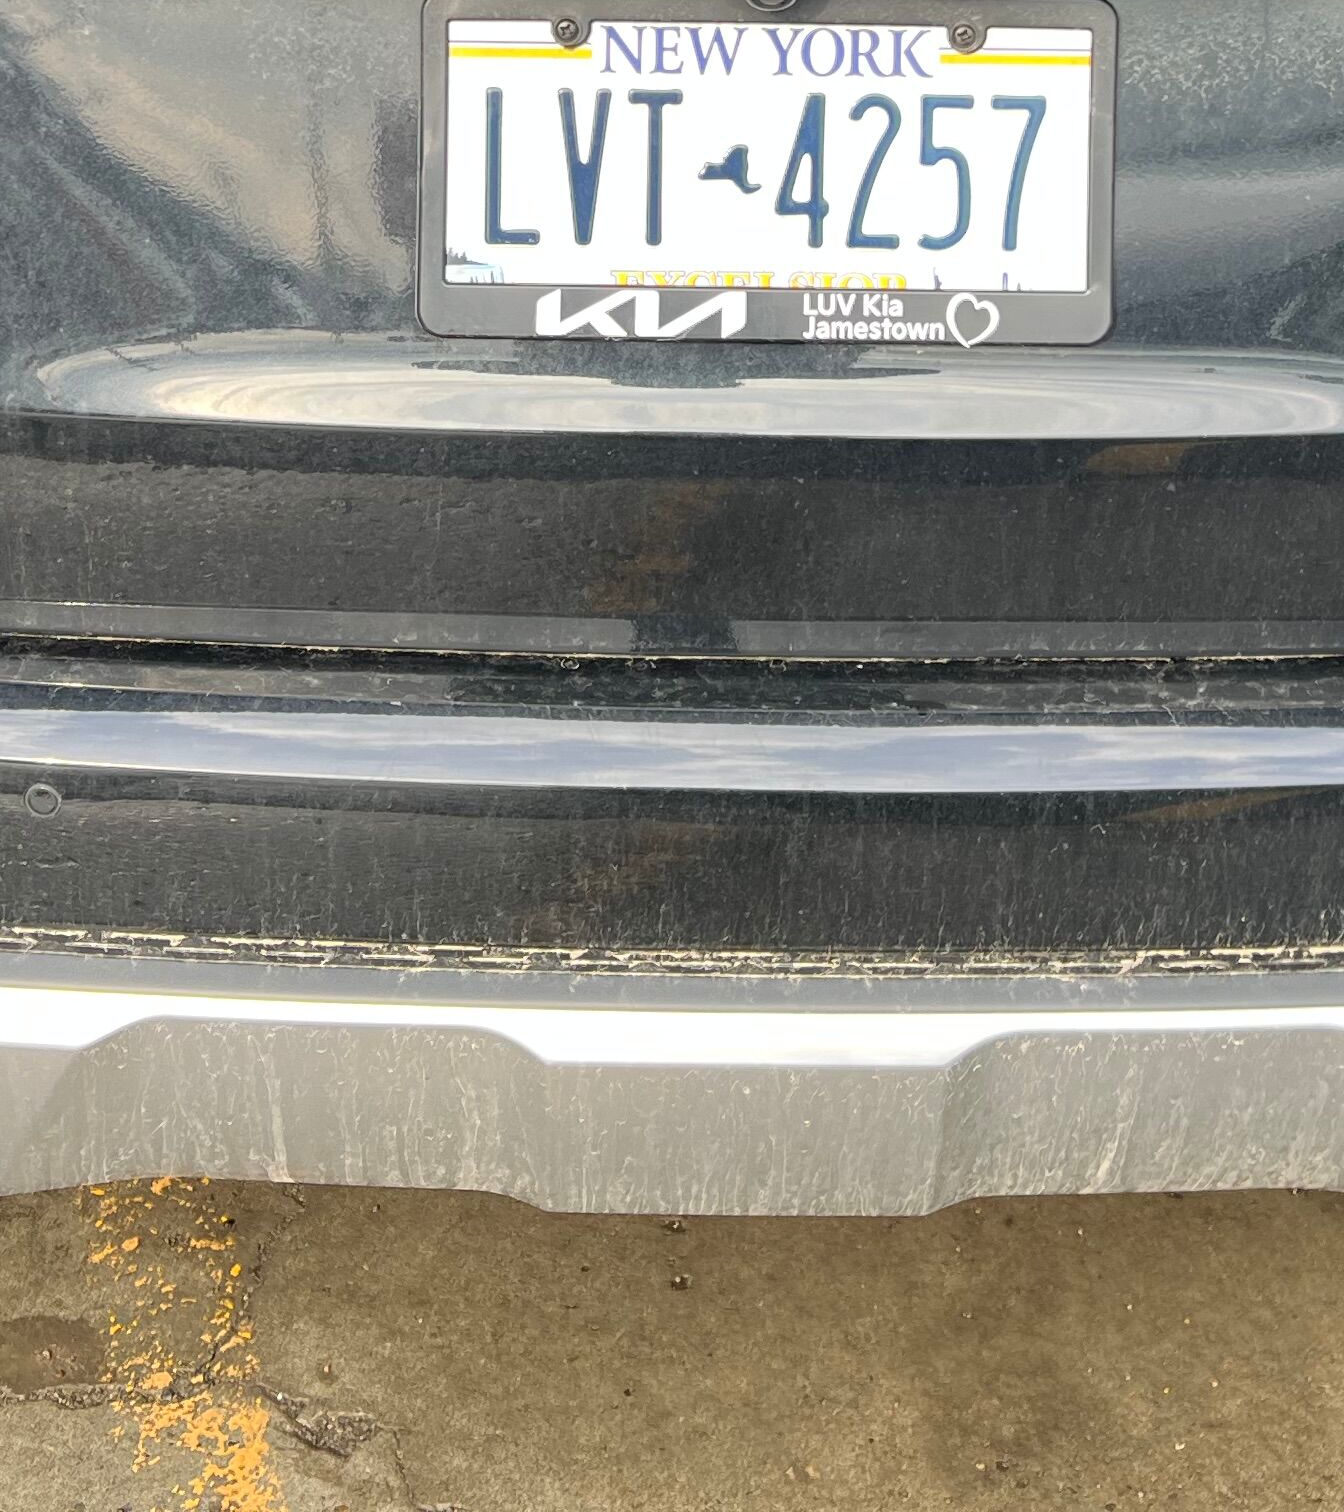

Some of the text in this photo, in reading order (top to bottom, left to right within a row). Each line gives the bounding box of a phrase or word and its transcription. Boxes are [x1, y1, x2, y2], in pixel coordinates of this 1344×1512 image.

[600, 24, 934, 78] NEW YORK
[485, 87, 1047, 251] LVT 4257
[535, 289, 747, 338] KIA
[802, 315, 946, 341] Jamestown
[803, 292, 905, 317] LUV Kia
